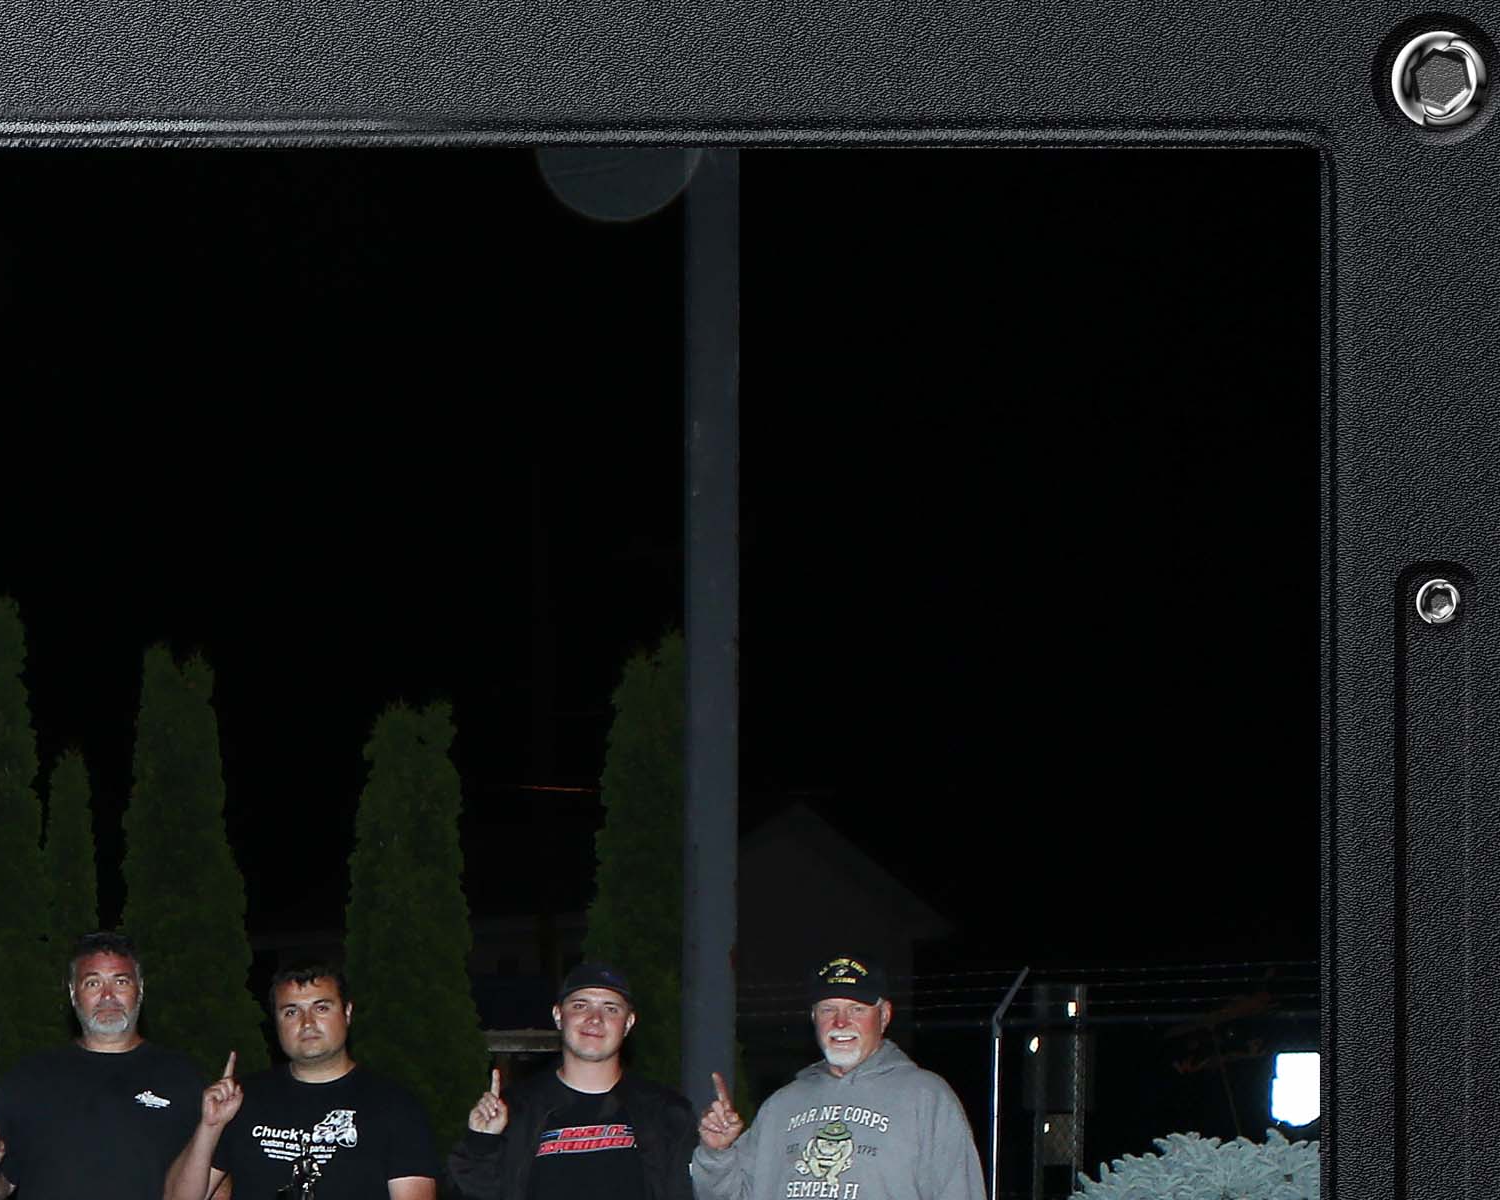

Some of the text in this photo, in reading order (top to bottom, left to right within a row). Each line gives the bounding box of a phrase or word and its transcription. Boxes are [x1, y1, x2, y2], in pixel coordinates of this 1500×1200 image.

[787, 1106, 889, 1133] MARNE CORPS
[252, 1125, 311, 1143] Chuck's
[786, 1181, 859, 1200] SEMPER FI
